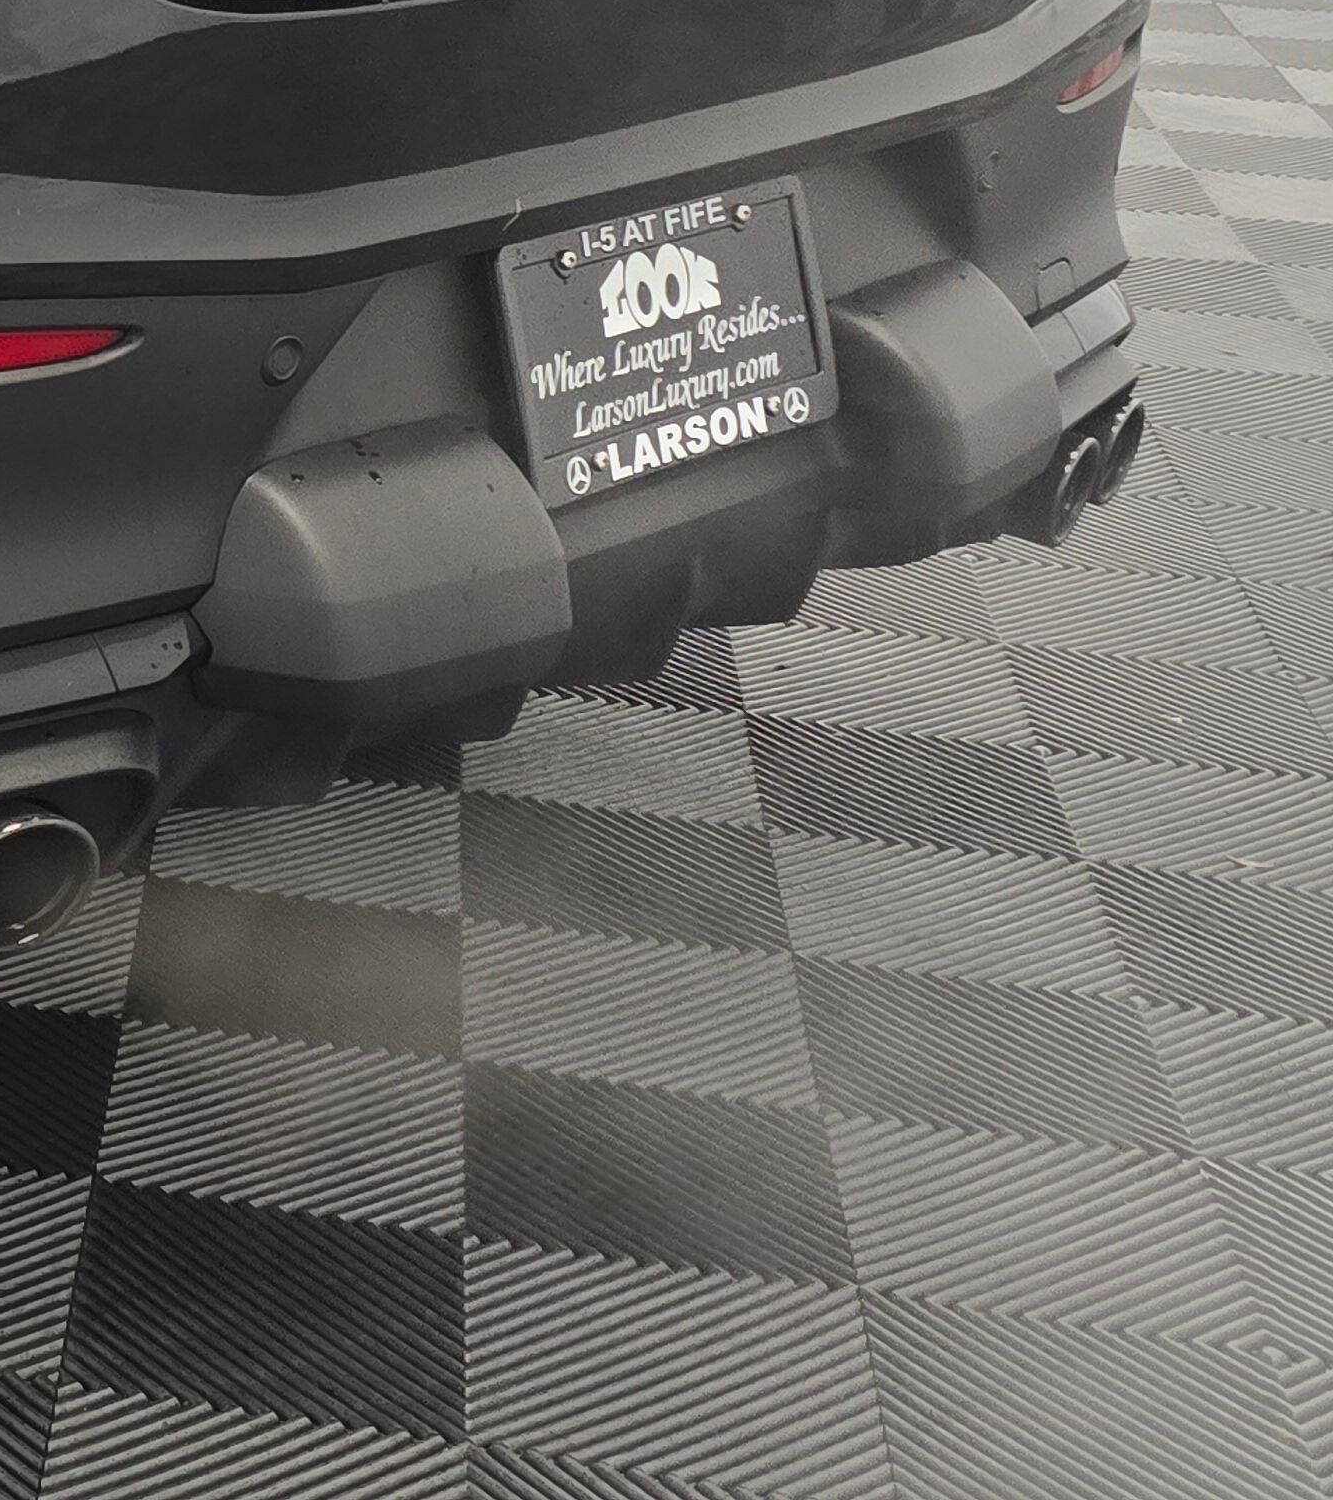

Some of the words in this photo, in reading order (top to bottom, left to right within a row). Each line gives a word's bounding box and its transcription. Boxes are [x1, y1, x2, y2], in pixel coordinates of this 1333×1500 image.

[580, 225, 617, 258] I-5
[622, 213, 657, 247] AT
[664, 196, 727, 236] FIFE
[531, 349, 606, 400] Where
[612, 329, 693, 378] Luxury
[698, 296, 807, 354] Resides...
[572, 350, 781, 439] LarsonLuxury.com
[607, 396, 768, 482] LARSON
